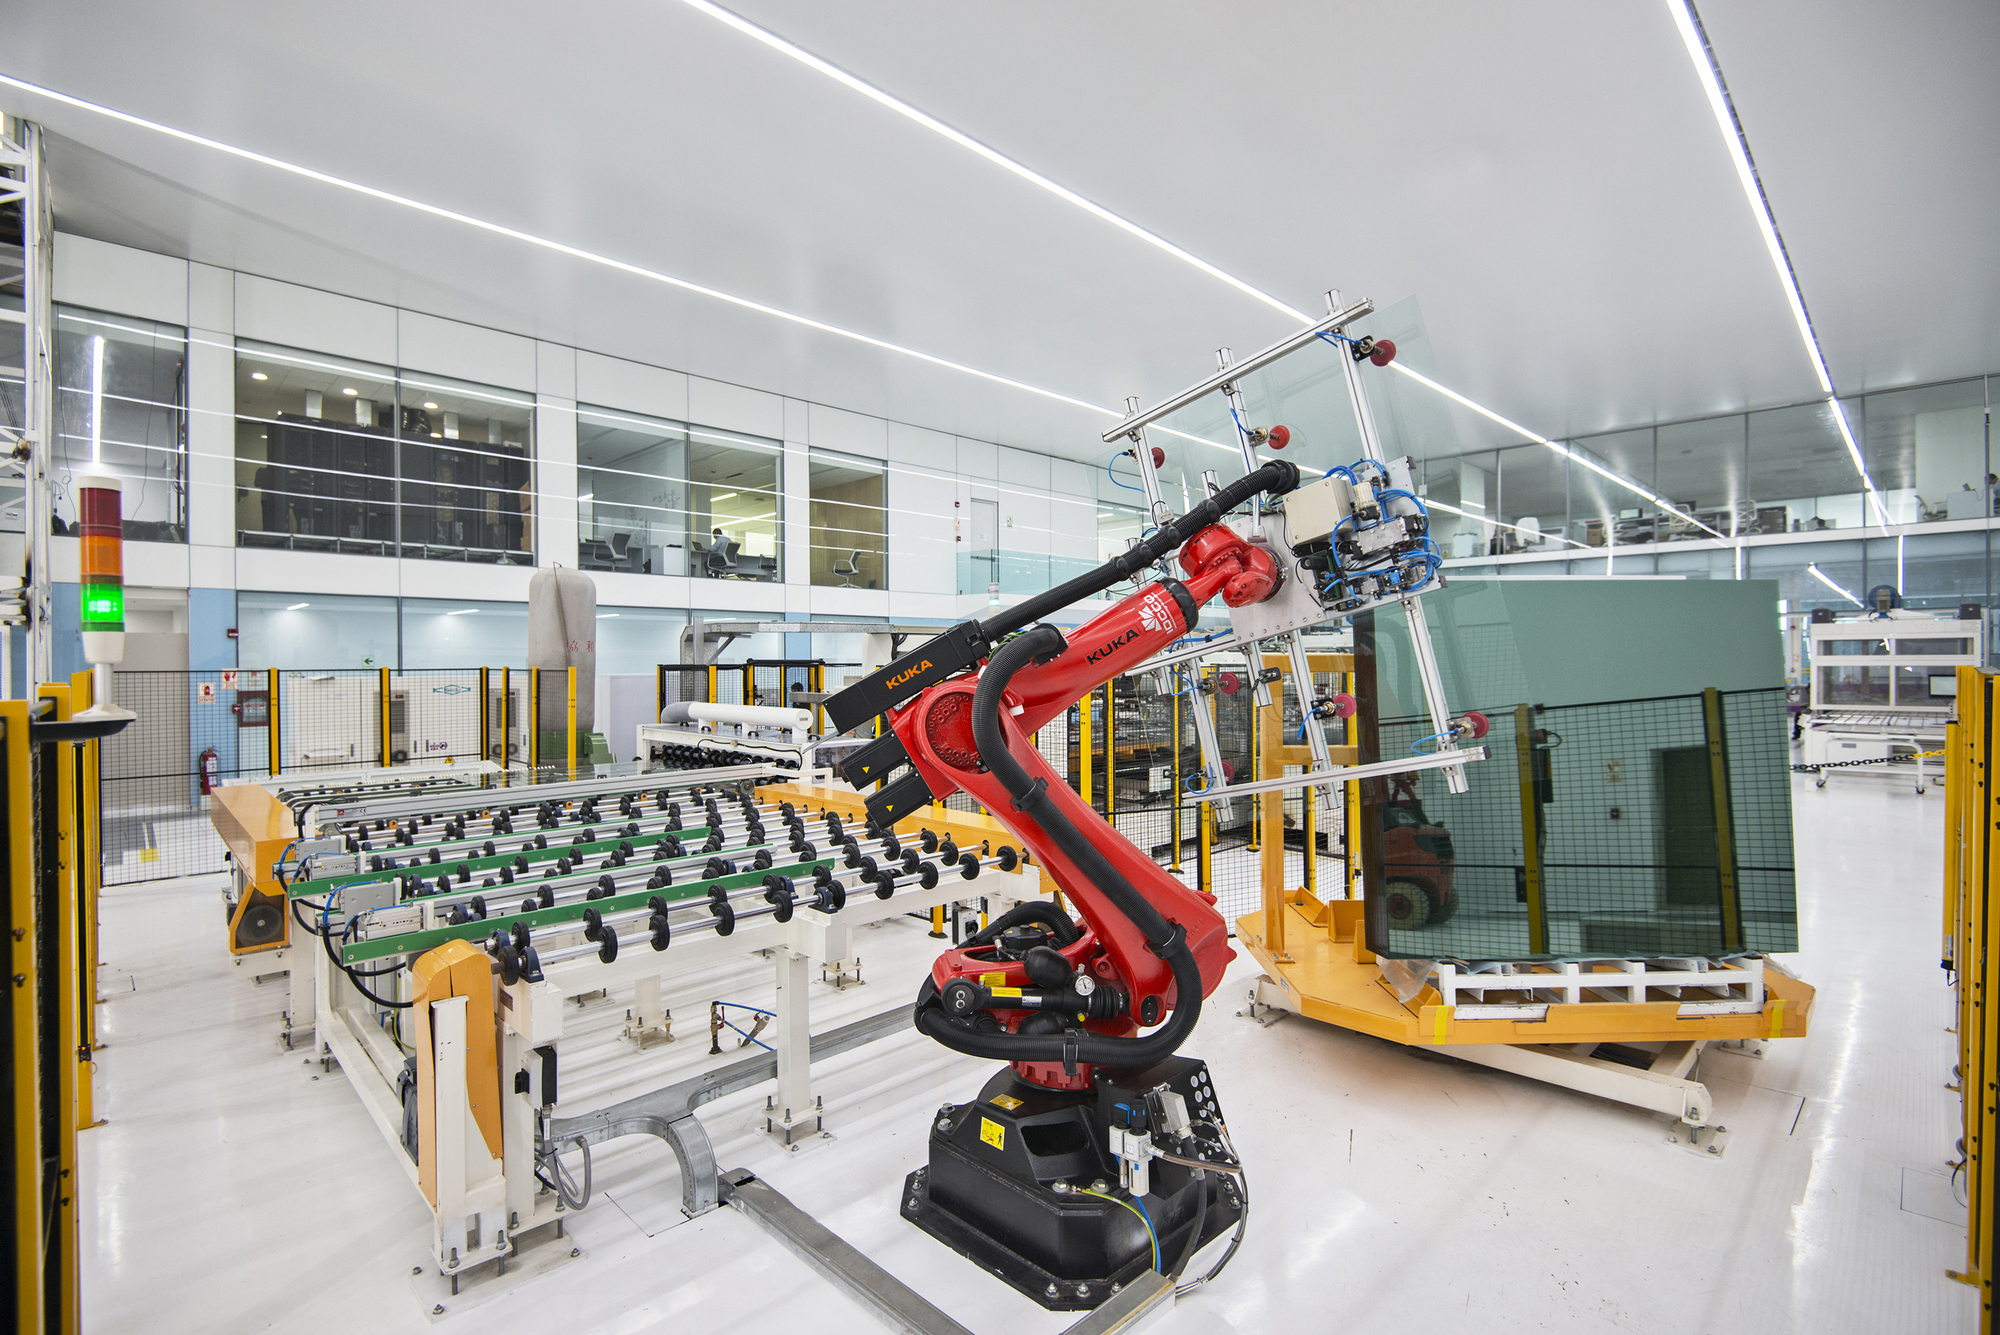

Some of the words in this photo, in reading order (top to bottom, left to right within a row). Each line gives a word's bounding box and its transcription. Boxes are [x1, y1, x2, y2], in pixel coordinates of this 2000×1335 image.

[1143, 594, 1174, 634] IOCCO
[1086, 629, 1140, 665] KUKA
[885, 659, 934, 690] KUKA
